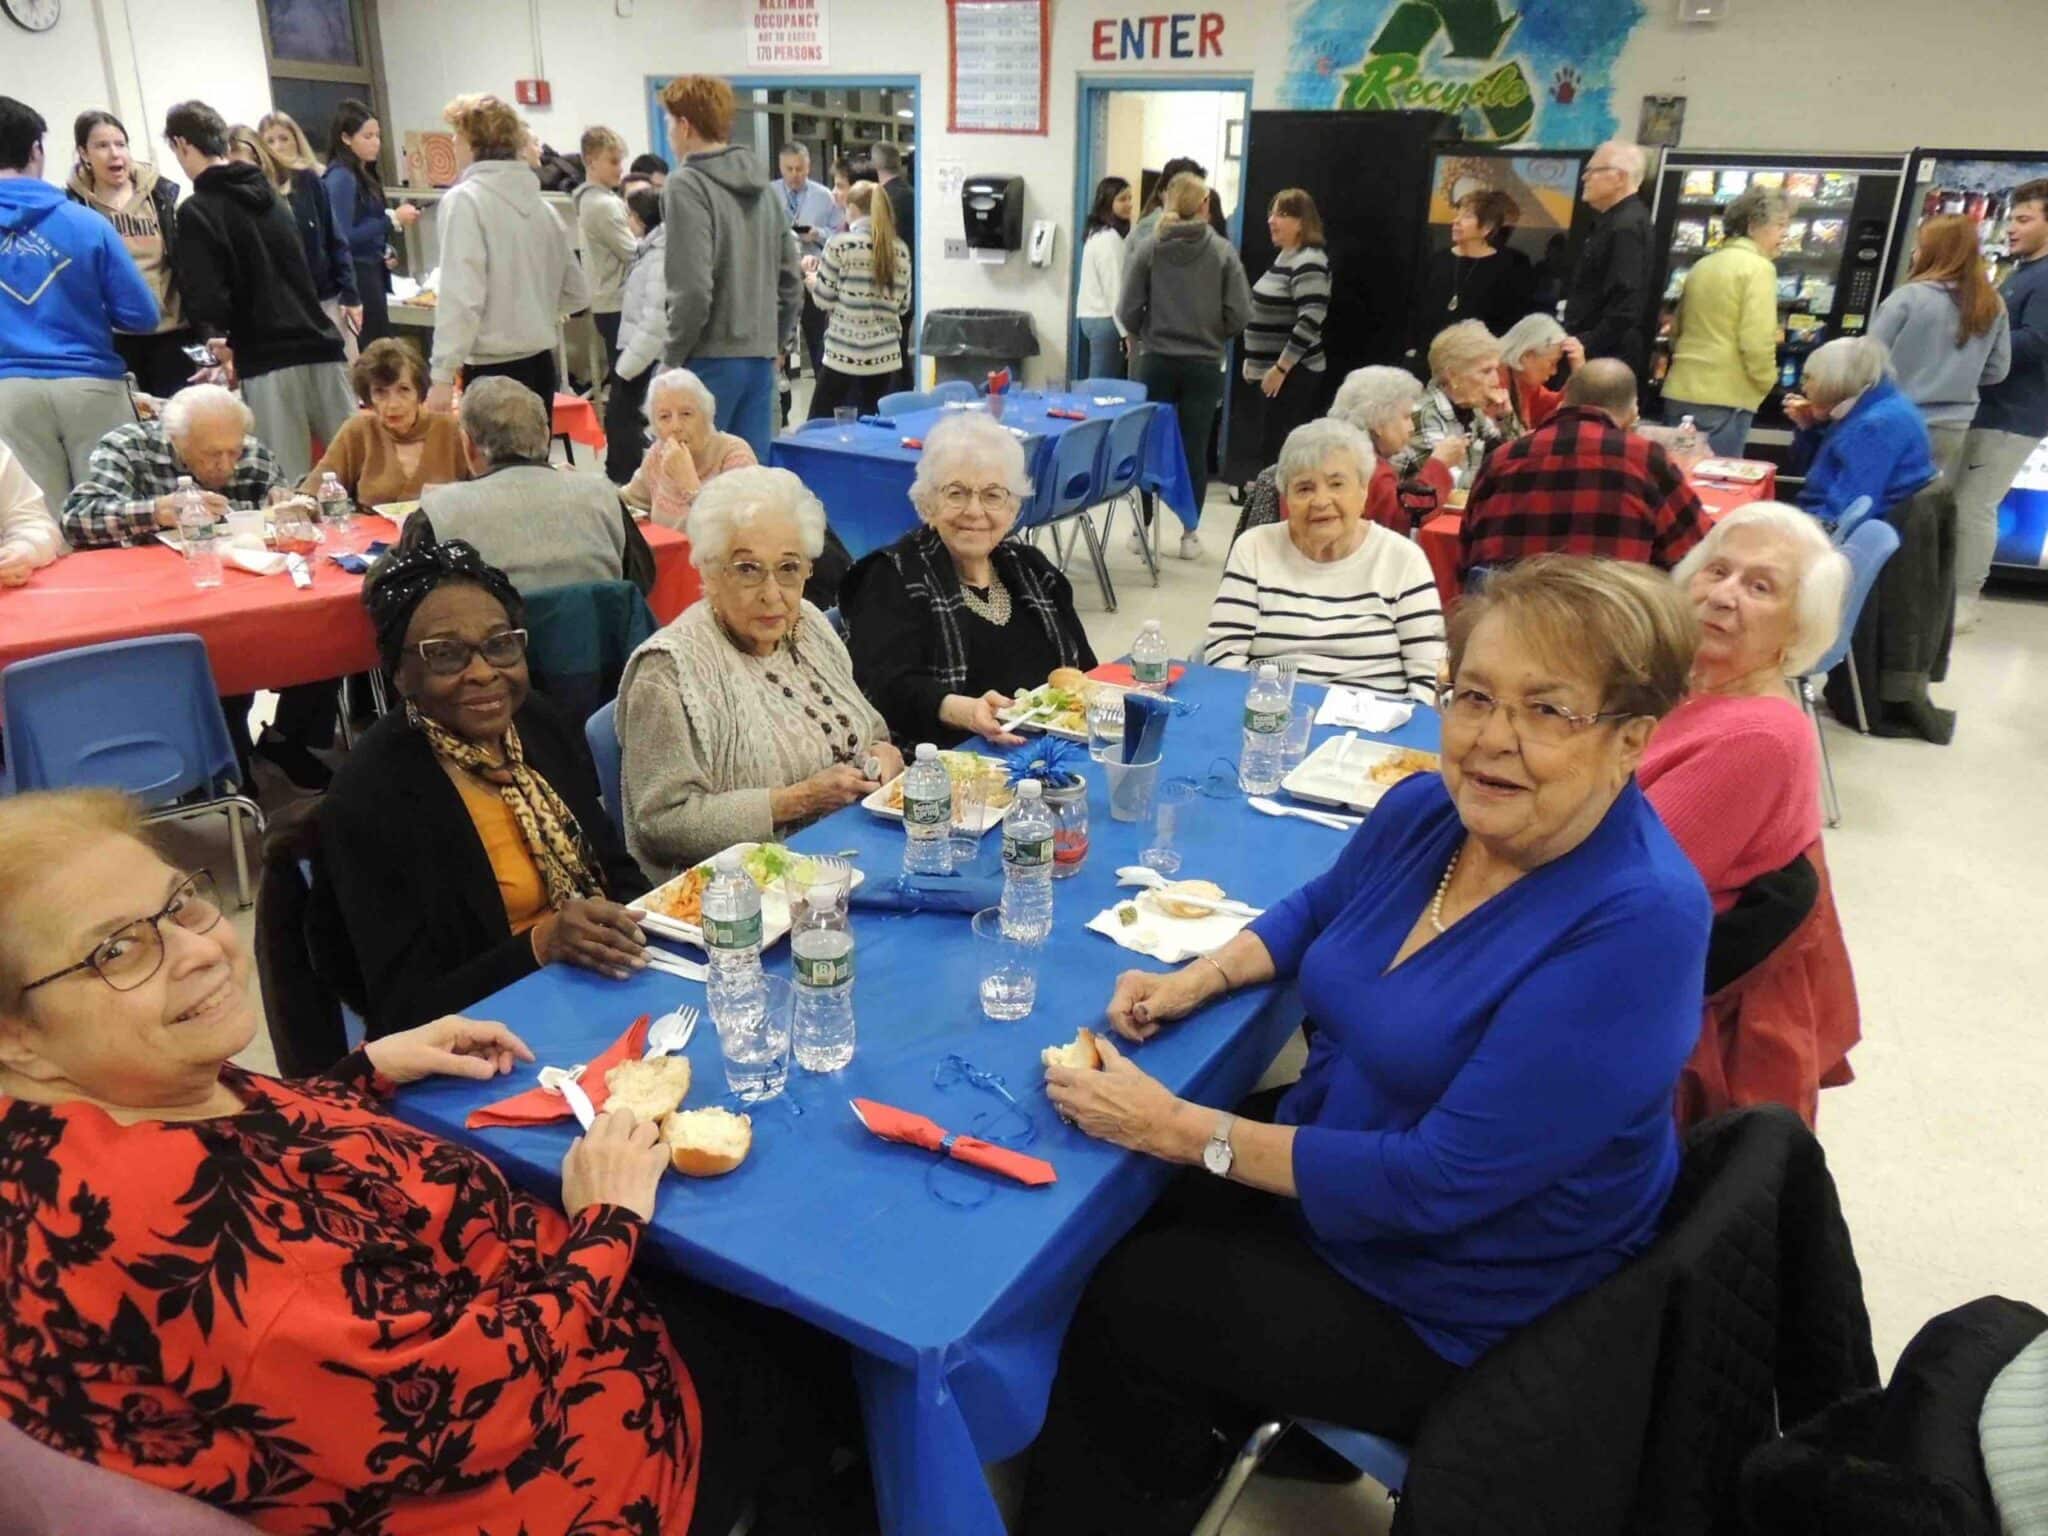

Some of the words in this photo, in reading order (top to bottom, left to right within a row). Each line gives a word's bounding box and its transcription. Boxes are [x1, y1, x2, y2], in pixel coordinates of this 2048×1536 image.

[754, 14, 819, 29] OCCUPANCY
[1092, 12, 1225, 61] ENTER
[774, 45, 823, 61] PERSONS
[1354, 52, 1529, 114] Recycle
